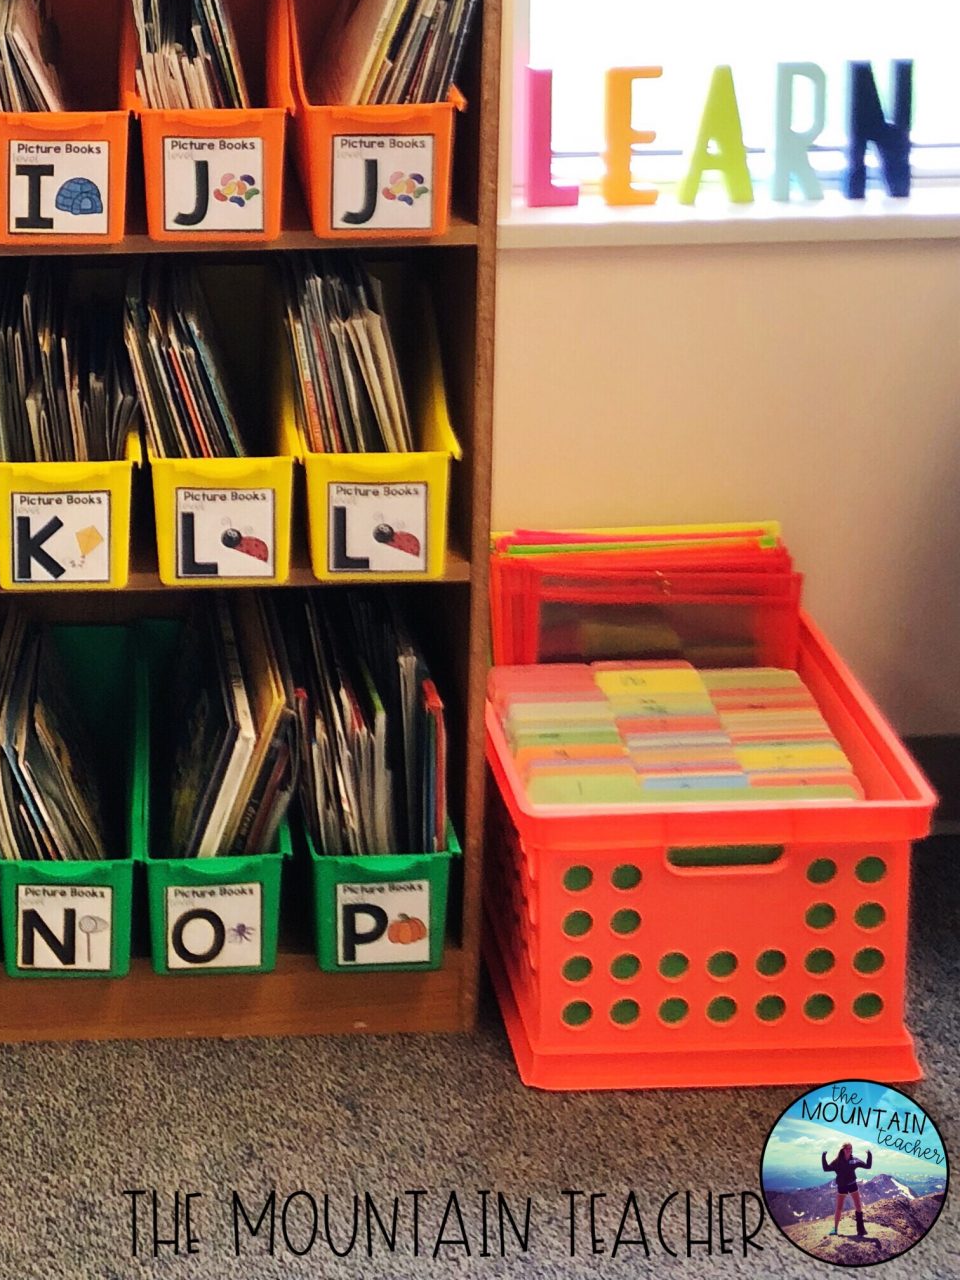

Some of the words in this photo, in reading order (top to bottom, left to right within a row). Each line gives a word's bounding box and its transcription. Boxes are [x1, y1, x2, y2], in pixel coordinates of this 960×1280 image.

[16, 143, 62, 155] Picture
[64, 143, 102, 155] Books
[171, 140, 215, 151] Picture
[218, 139, 256, 151] Books
[340, 138, 385, 150] Picture
[388, 138, 426, 149] Books
[525, 58, 914, 207] LEARN
[15, 164, 54, 230] I
[172, 159, 209, 226] J
[341, 159, 378, 225] J
[19, 495, 63, 507] Picture
[66, 494, 102, 506] Books
[183, 490, 227, 503] Picture
[230, 490, 267, 502] Books
[335, 485, 380, 497] Picture
[383, 485, 419, 496] Books
[16, 515, 66, 580] K
[181, 511, 219, 576] L
[333, 505, 370, 570] L
[24, 887, 67, 898] Picture
[70, 888, 105, 899] Books
[173, 888, 216, 899] Picture
[218, 887, 254, 898] Books
[342, 883, 385, 894] Picture
[388, 883, 423, 894] Books
[21, 908, 76, 966] N
[171, 908, 226, 964] O
[342, 902, 388, 962] P
